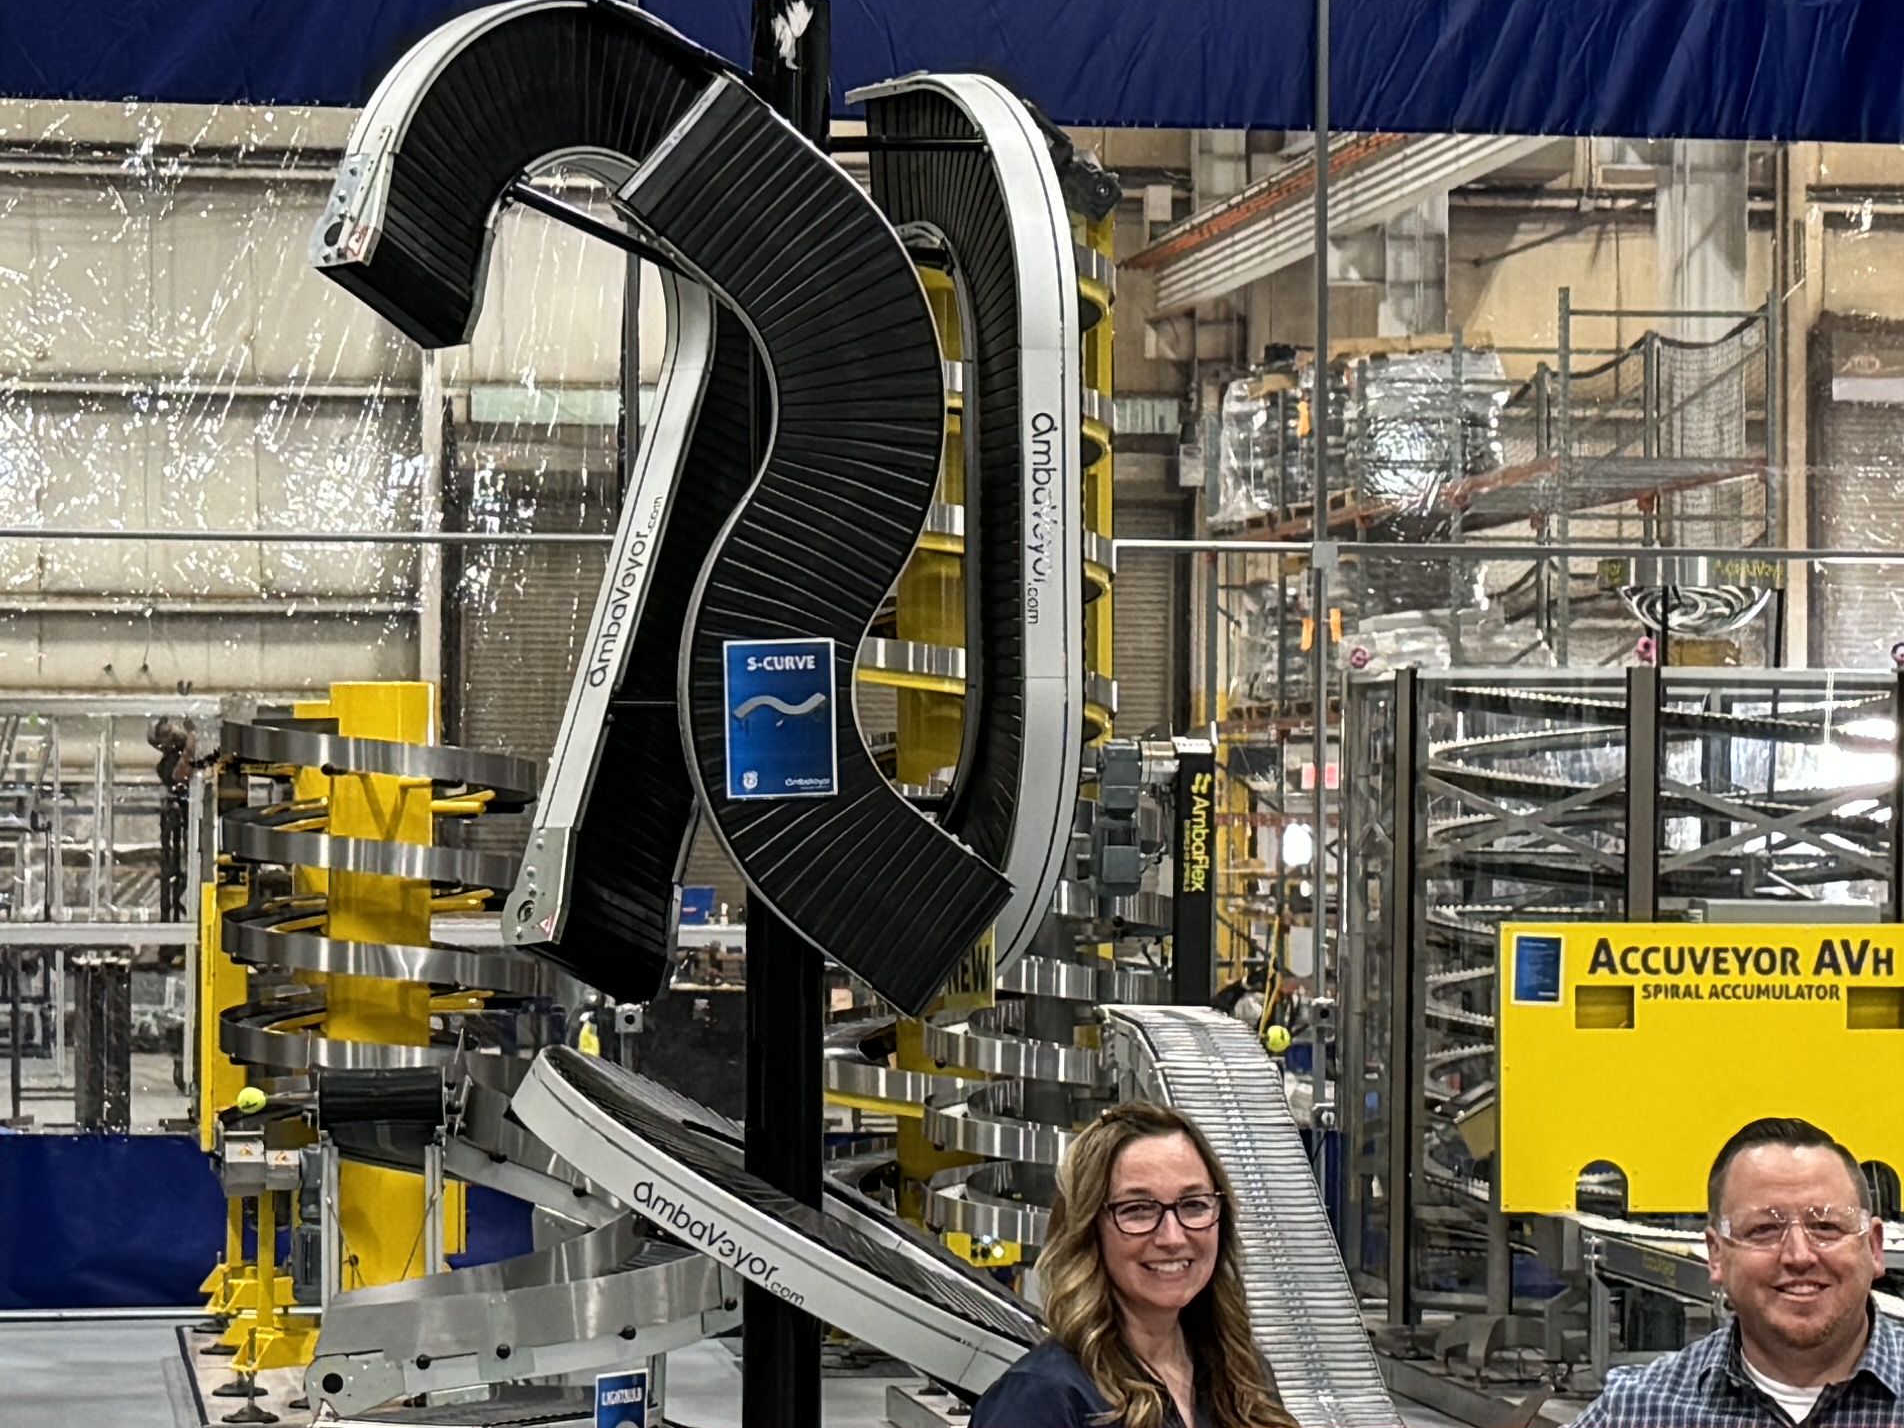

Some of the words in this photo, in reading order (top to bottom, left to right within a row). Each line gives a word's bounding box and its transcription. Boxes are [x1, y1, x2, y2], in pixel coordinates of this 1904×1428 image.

[747, 655, 816, 671] S-CURVE
[1191, 795, 1210, 892] AmbaFlex
[1641, 983, 1704, 1000] SPIRAL
[1708, 983, 1841, 1001] ACCUMULATOR
